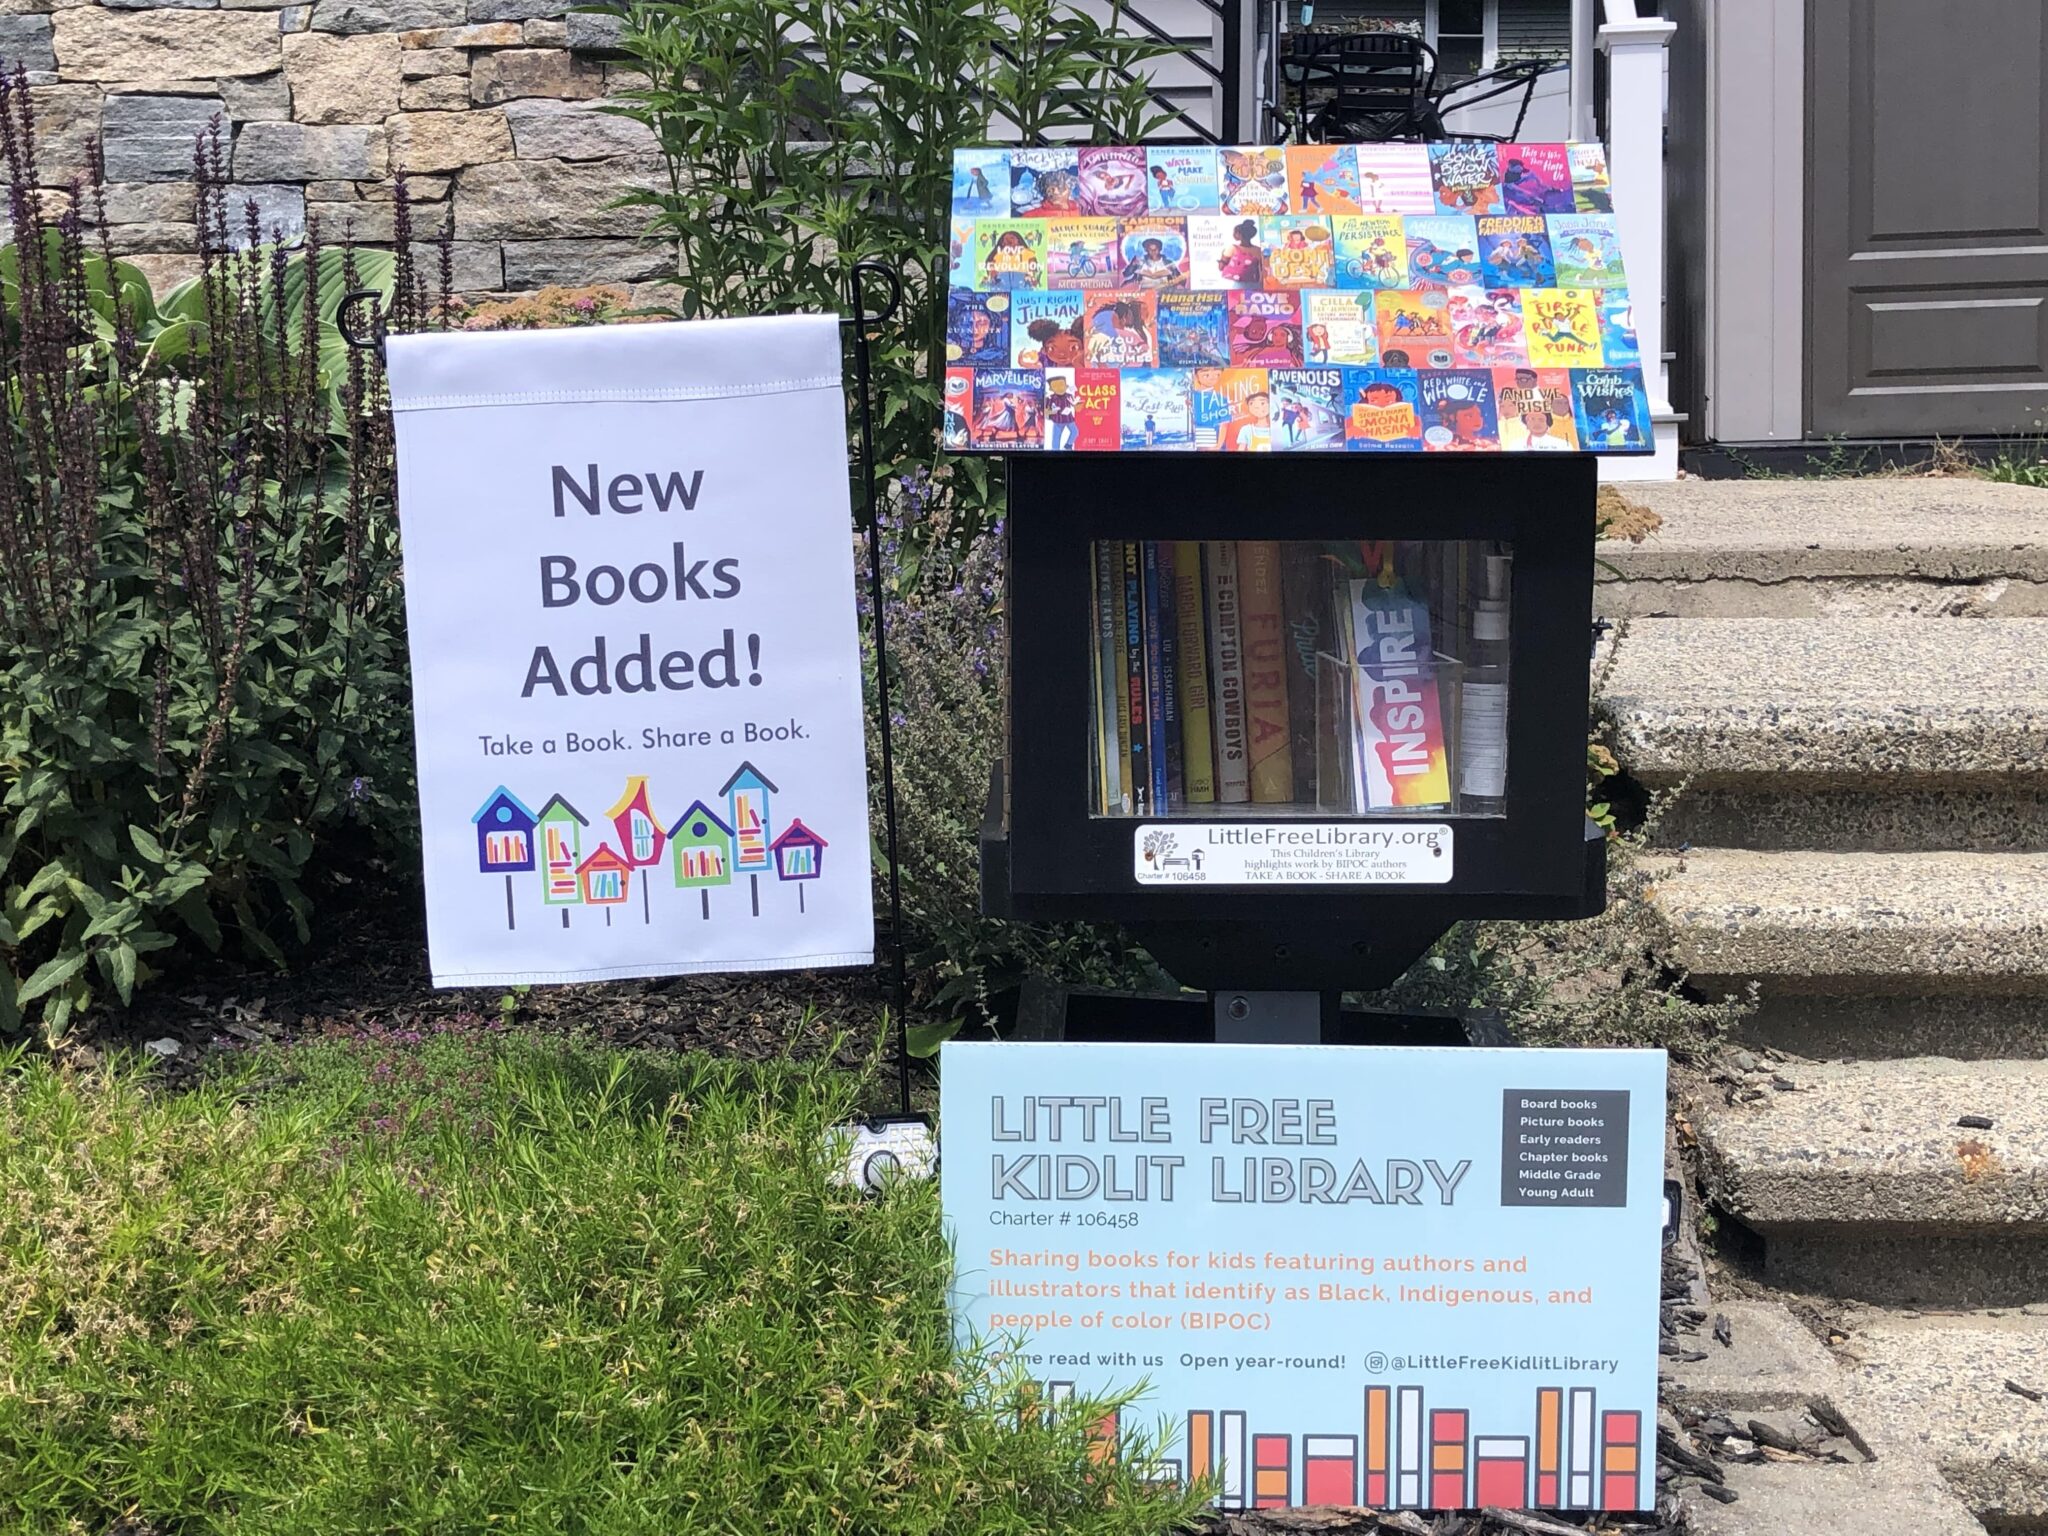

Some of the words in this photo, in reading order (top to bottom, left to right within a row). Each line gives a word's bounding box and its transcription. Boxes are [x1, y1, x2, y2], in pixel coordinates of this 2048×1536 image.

[1240, 293, 1289, 304] LOVE
[1235, 304, 1294, 315] RADIO
[976, 373, 1041, 389] MARVELLERS
[1272, 369, 1341, 386] RAVENOUS
[1586, 374, 1622, 388] Comb
[1079, 384, 1116, 396] CLASS
[1504, 389, 1533, 400] AND
[1538, 388, 1562, 400] WE
[1577, 384, 1634, 399] Wishes
[1085, 397, 1110, 410] ACT
[1517, 401, 1551, 414] RISE
[1201, 403, 1242, 423] SHORT
[1365, 414, 1408, 426] MONA
[1366, 423, 1410, 437] HASAN
[550, 463, 704, 517] New
[1125, 543, 1137, 575] NOT
[539, 541, 742, 608] Books
[1127, 580, 1139, 645] PLAYING
[1217, 589, 1238, 672] COMPTON
[520, 628, 764, 698] Added!
[1250, 613, 1284, 744] FURIA
[1163, 665, 1174, 722] ISSAKHANIAN
[1376, 608, 1430, 776] INSPIRE
[1130, 676, 1144, 725] RULES
[1222, 677, 1243, 761] COWBOYS
[478, 734, 533, 756] Take
[542, 740, 556, 753] a
[566, 729, 633, 753] Book.
[641, 727, 711, 749] Share
[720, 731, 735, 744] a
[744, 718, 811, 743] Book.
[1270, 849, 1291, 858] This
[1345, 849, 1380, 860] Library
[1244, 859, 1292, 871] highlights
[1295, 860, 1319, 868] work
[1321, 860, 1333, 871] by
[1336, 859, 1368, 868] BIPOC
[1371, 860, 1407, 868] authors
[1172, 872, 1206, 880] 106458
[1245, 871, 1274, 880] TAKE
[1276, 872, 1283, 880] A
[1286, 871, 1317, 880] BOOK
[1326, 871, 1362, 880] SHARE
[1364, 872, 1372, 880] A
[1375, 871, 1406, 880] BOOK
[1520, 1099, 1557, 1109] Board
[1560, 1099, 1597, 1109] books
[991, 1095, 1172, 1144] LITTLE
[1199, 1097, 1338, 1146] FREE
[1520, 1116, 1564, 1127] Picture
[1567, 1117, 1604, 1127] books
[1520, 1134, 1551, 1146] Early
[1554, 1135, 1601, 1145] readers
[1519, 1152, 1568, 1164] Chapter
[1571, 1152, 1608, 1163] books
[991, 1154, 1185, 1202] KIDLIT
[1212, 1156, 1473, 1206] LIBRARY
[1519, 1169, 1561, 1180] Middle
[1564, 1170, 1601, 1180] Grade
[1519, 1187, 1557, 1199] Young
[1561, 1187, 1594, 1198] Adult
[989, 1210, 1054, 1227] Charter
[1059, 1211, 1071, 1226] #
[1076, 1211, 1139, 1228] 106458
[990, 1249, 1080, 1271] Sharing
[1088, 1250, 1159, 1268] books
[1166, 1250, 1200, 1268] for
[1208, 1251, 1256, 1269] kids
[1264, 1251, 1375, 1275] featuring
[1383, 1254, 1475, 1273] authors
[1483, 1256, 1528, 1273] and
[990, 1279, 1121, 1297] illustrators
[1129, 1281, 1176, 1299] that
[1185, 1282, 1276, 1304] identify
[1284, 1287, 1310, 1300] as
[1319, 1284, 1391, 1303] Black,
[1399, 1285, 1540, 1306] Indigenous,
[1548, 1287, 1593, 1304] and
[990, 1310, 1073, 1331] people
[1080, 1311, 1104, 1328] of
[1111, 1311, 1173, 1329] color
[1180, 1311, 1271, 1331] (BIPOC)
[1049, 1352, 1090, 1366] read
[1097, 1352, 1136, 1366] with
[1143, 1355, 1164, 1367] us
[1179, 1353, 1229, 1370] Open
[1235, 1354, 1345, 1371] year-round!
[1391, 1354, 1619, 1374] @LittleFreeKidlitLibrary
